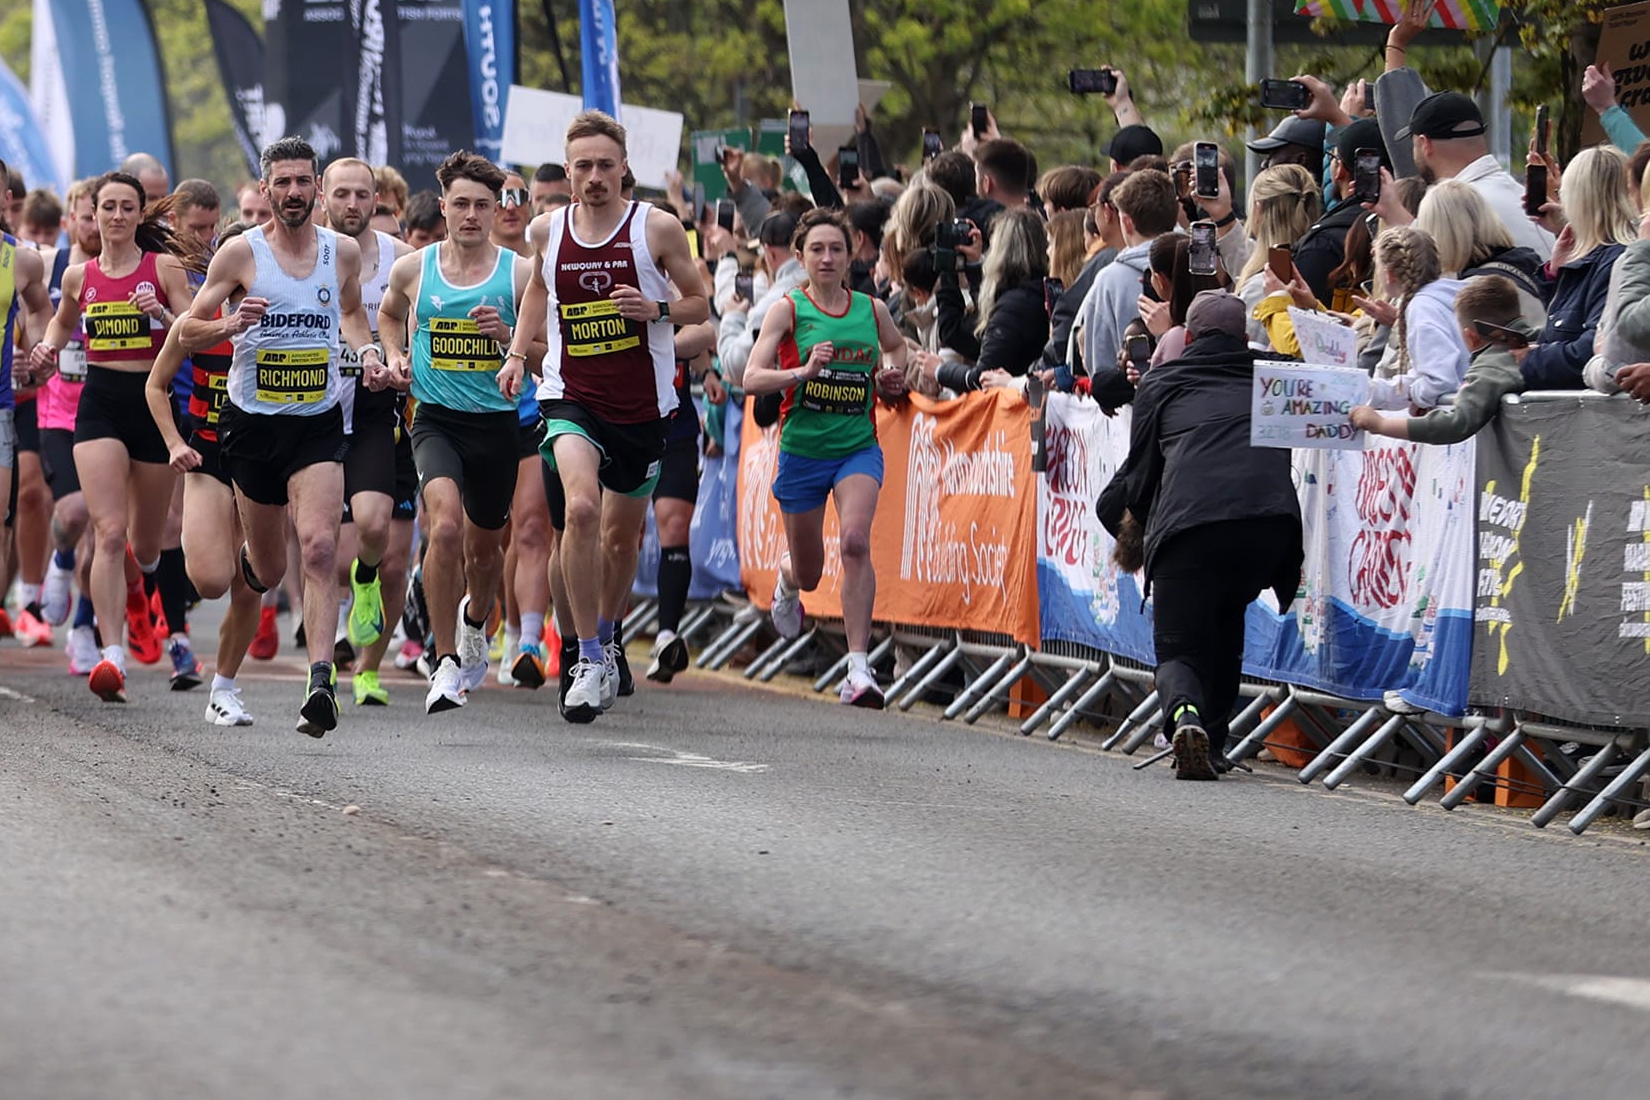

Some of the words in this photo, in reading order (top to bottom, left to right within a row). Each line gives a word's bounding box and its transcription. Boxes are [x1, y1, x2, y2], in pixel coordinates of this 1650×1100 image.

[94, 318, 139, 335] DIMOND
[260, 313, 331, 329] BIDEFORD
[572, 318, 626, 340] MORTON
[432, 336, 499, 355] GOODCHILD
[262, 353, 286, 362] ABP
[259, 368, 326, 387] RICHMOND
[805, 380, 865, 401] ROBINSON
[1281, 399, 1351, 415] AMAZING
[1305, 423, 1359, 441] DADDY
